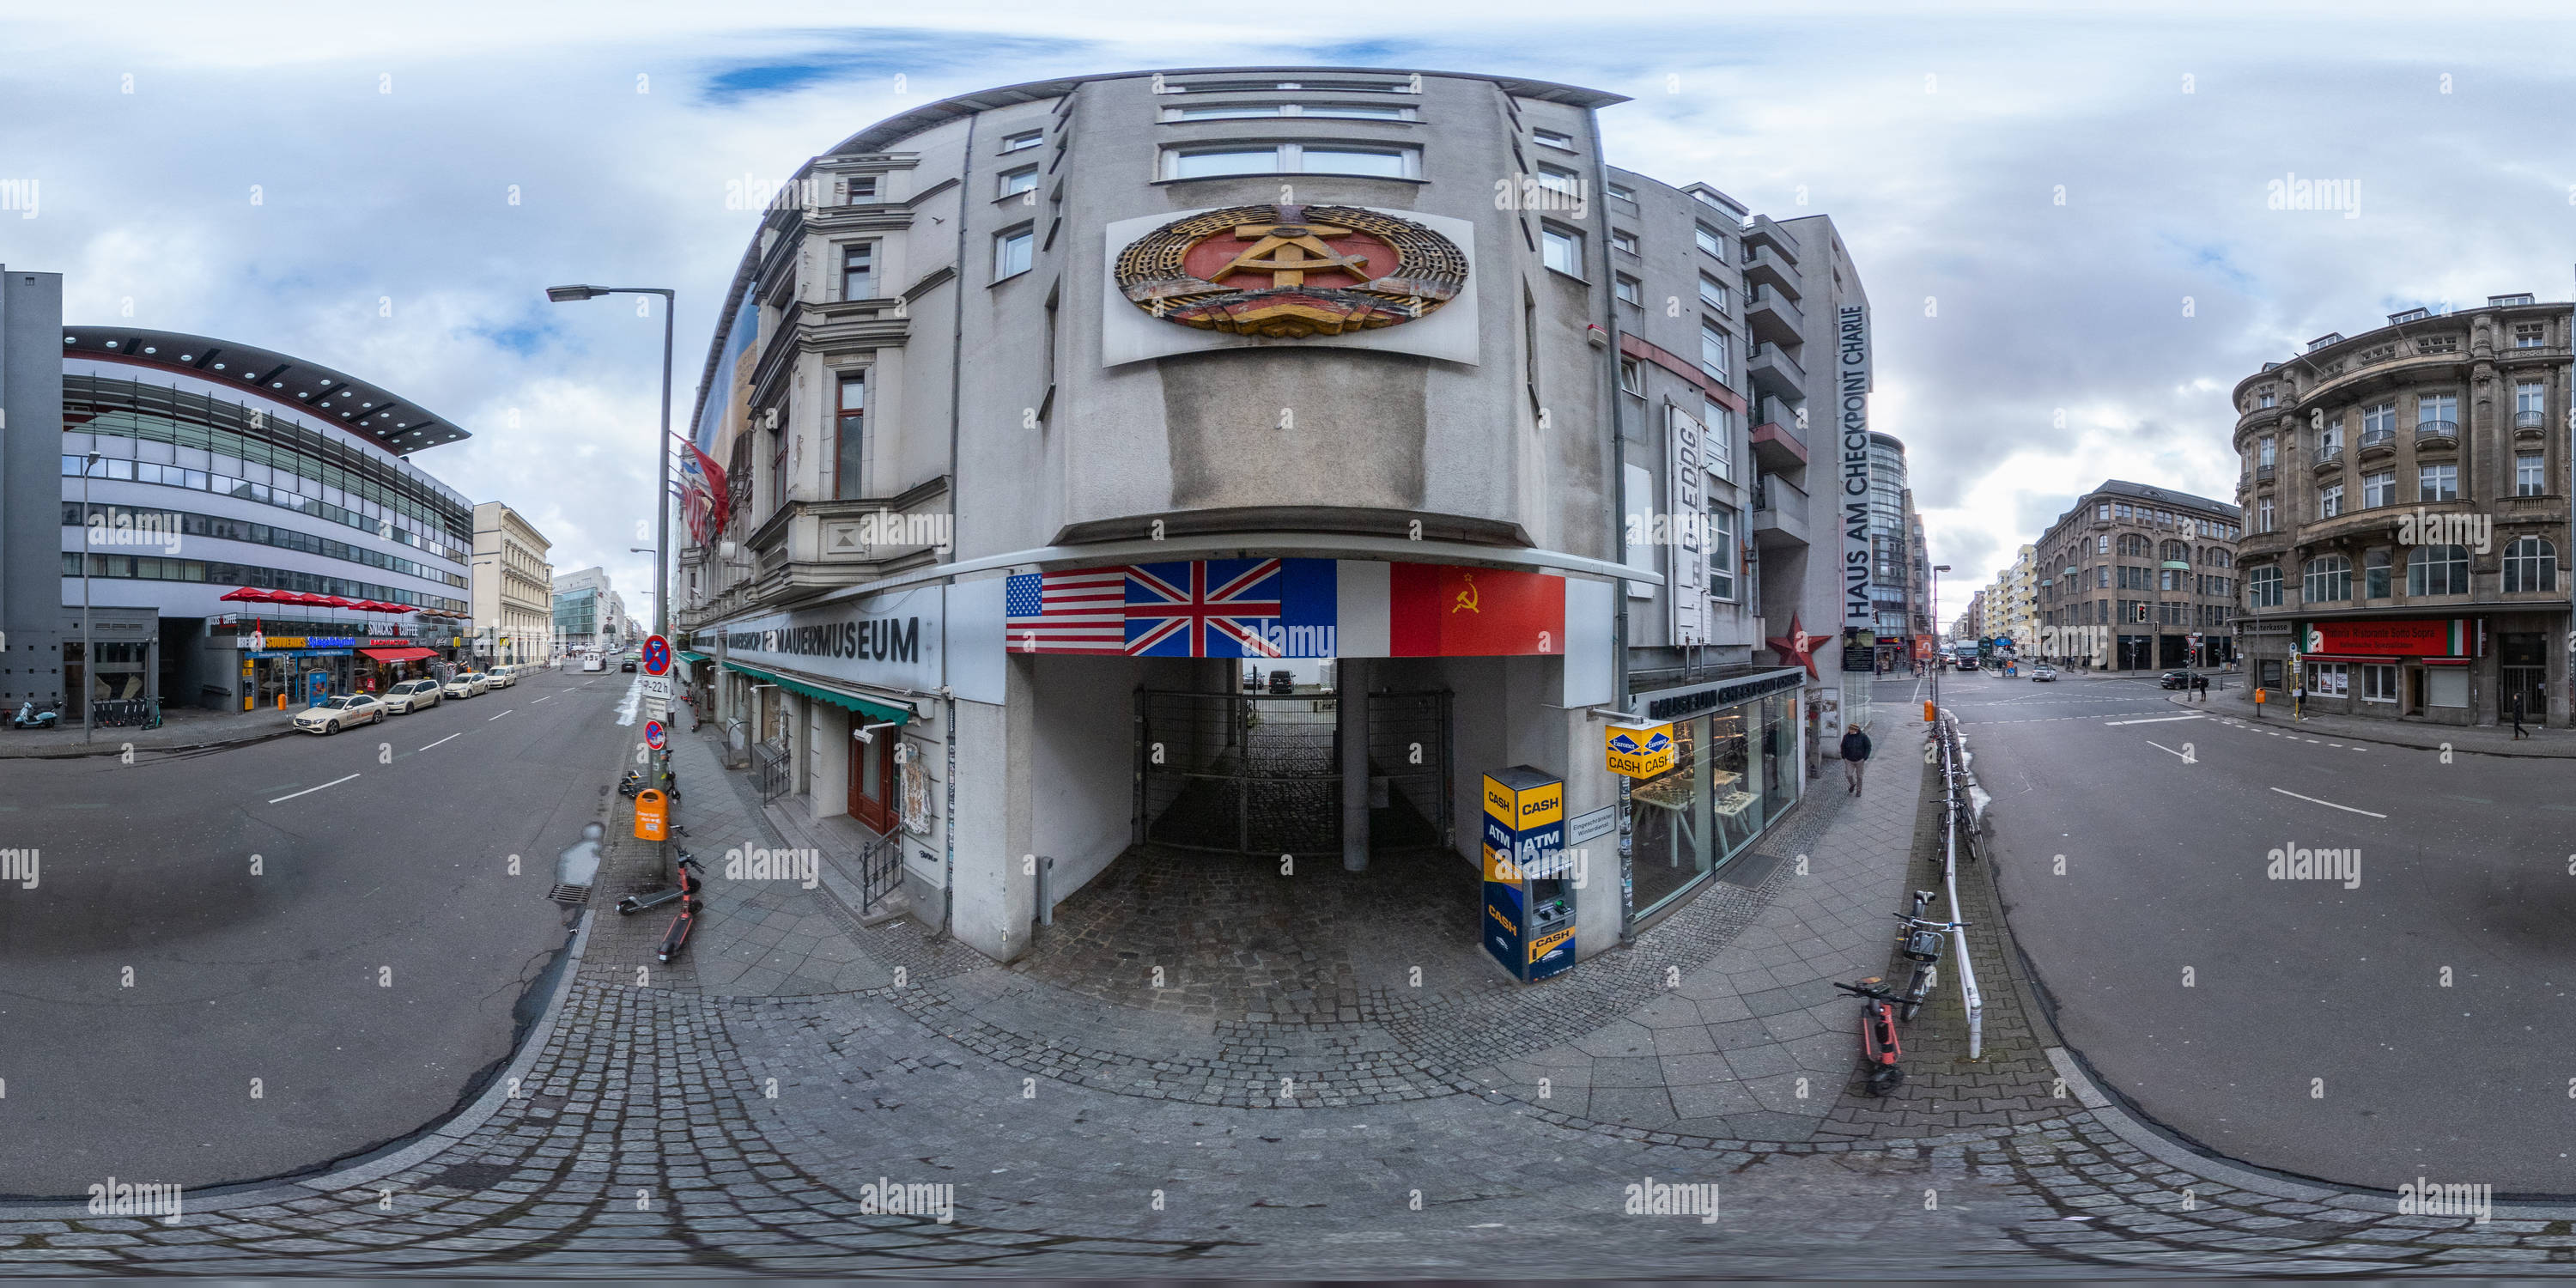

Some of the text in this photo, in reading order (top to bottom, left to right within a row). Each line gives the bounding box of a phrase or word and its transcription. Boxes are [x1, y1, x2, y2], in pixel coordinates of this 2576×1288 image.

[1841, 306, 1869, 618] HAUS AM CHECKPOINT CHARLIE
[368, 622, 393, 635] SNACKS
[399, 623, 418, 635] COFFEE
[2246, 623, 2288, 632] Theterkasse
[1613, 738, 1635, 750] Euronet
[1609, 756, 1640, 774] CASH
[1645, 753, 1672, 773] CASH
[1488, 791, 1510, 813] CASH
[1522, 797, 1559, 816] CASH
[1489, 823, 1510, 849] ATM
[1522, 830, 1559, 853] ATM
[1488, 904, 1517, 937] CASH
[1535, 930, 1570, 948] CASH
